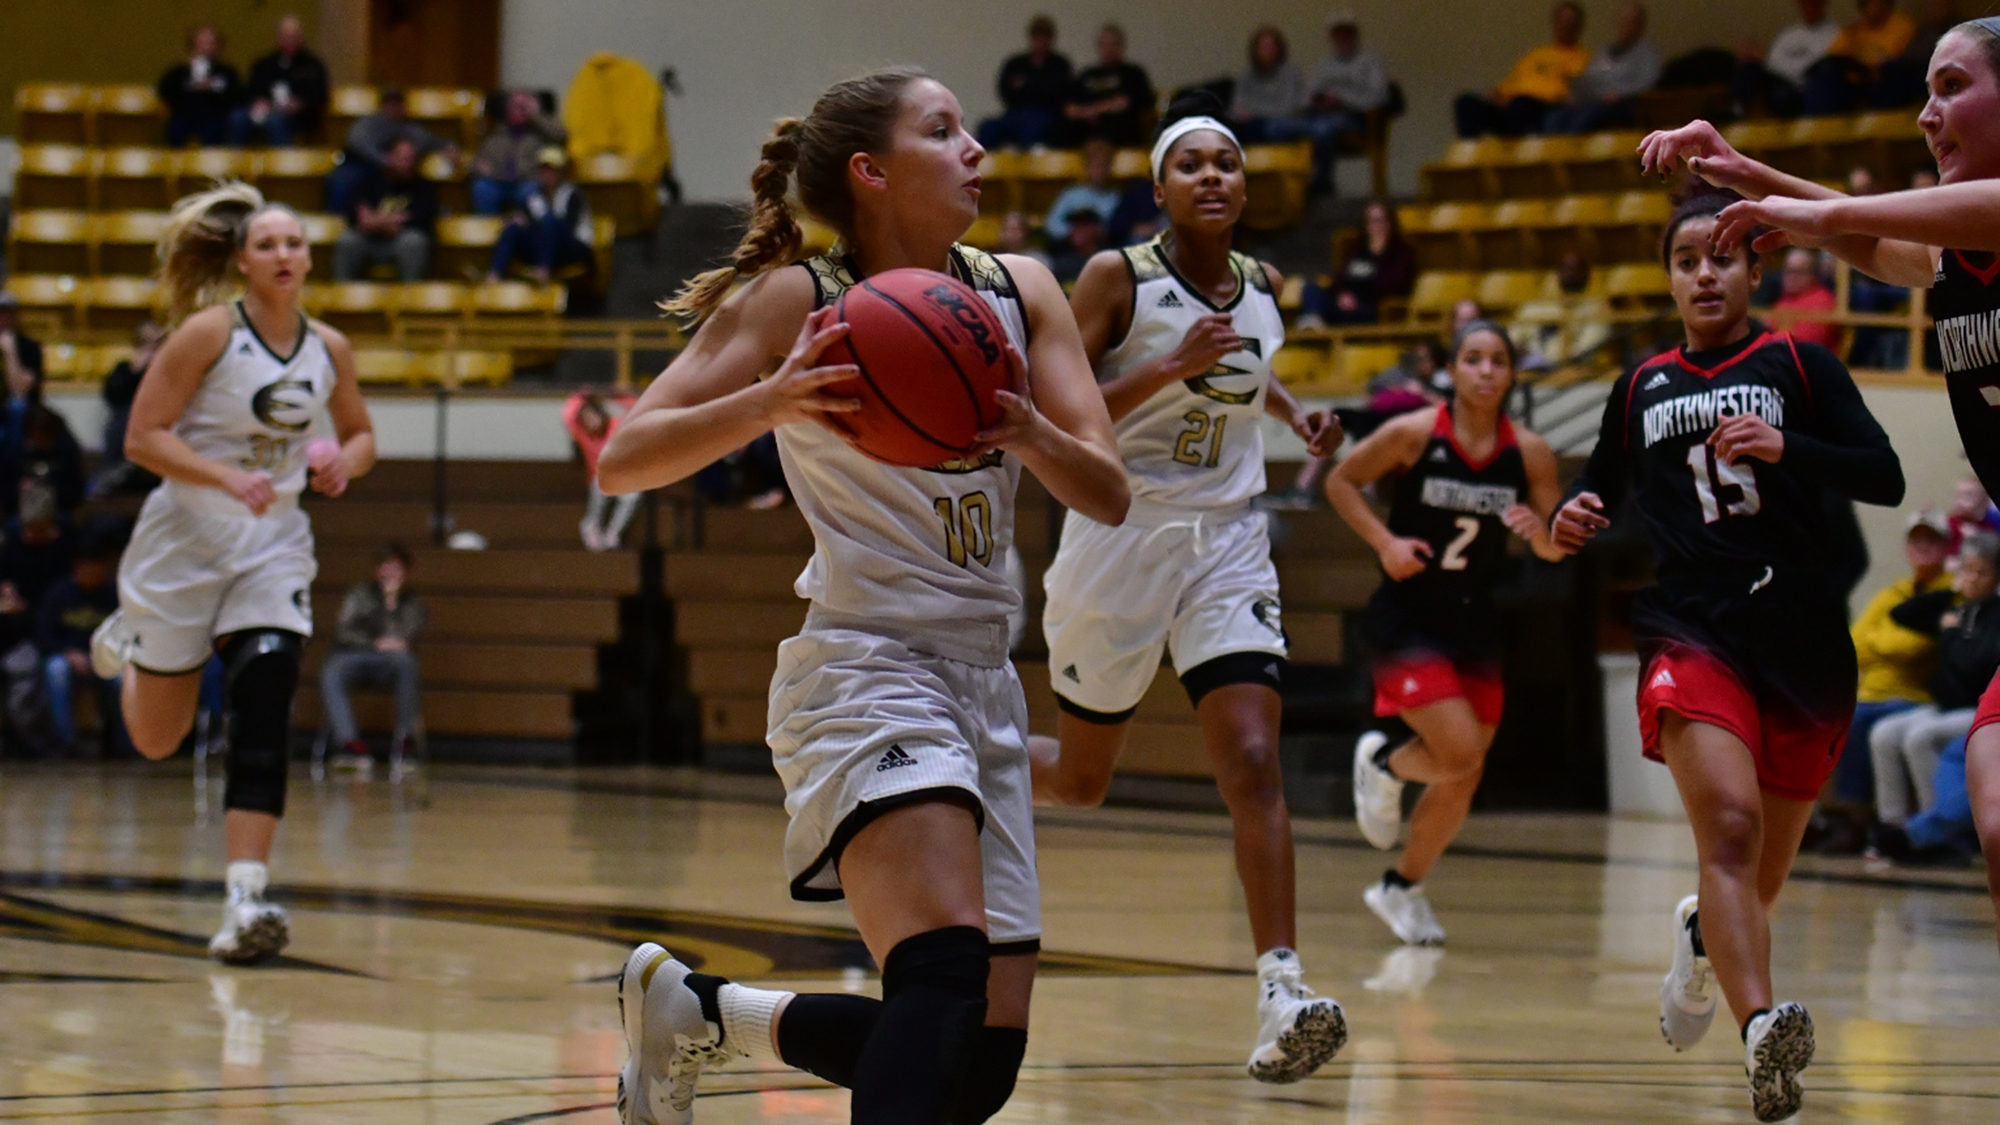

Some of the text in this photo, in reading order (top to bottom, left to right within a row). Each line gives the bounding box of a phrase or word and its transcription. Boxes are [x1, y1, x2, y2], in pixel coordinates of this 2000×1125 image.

[924, 284, 1000, 367] NCAA
[1173, 410, 1228, 468] 21
[1643, 384, 1784, 449] NORTHWESTERN
[1687, 443, 1761, 525] 15
[933, 490, 995, 568] 10
[1440, 516, 1481, 571] 2
[876, 757, 918, 773] adidas
